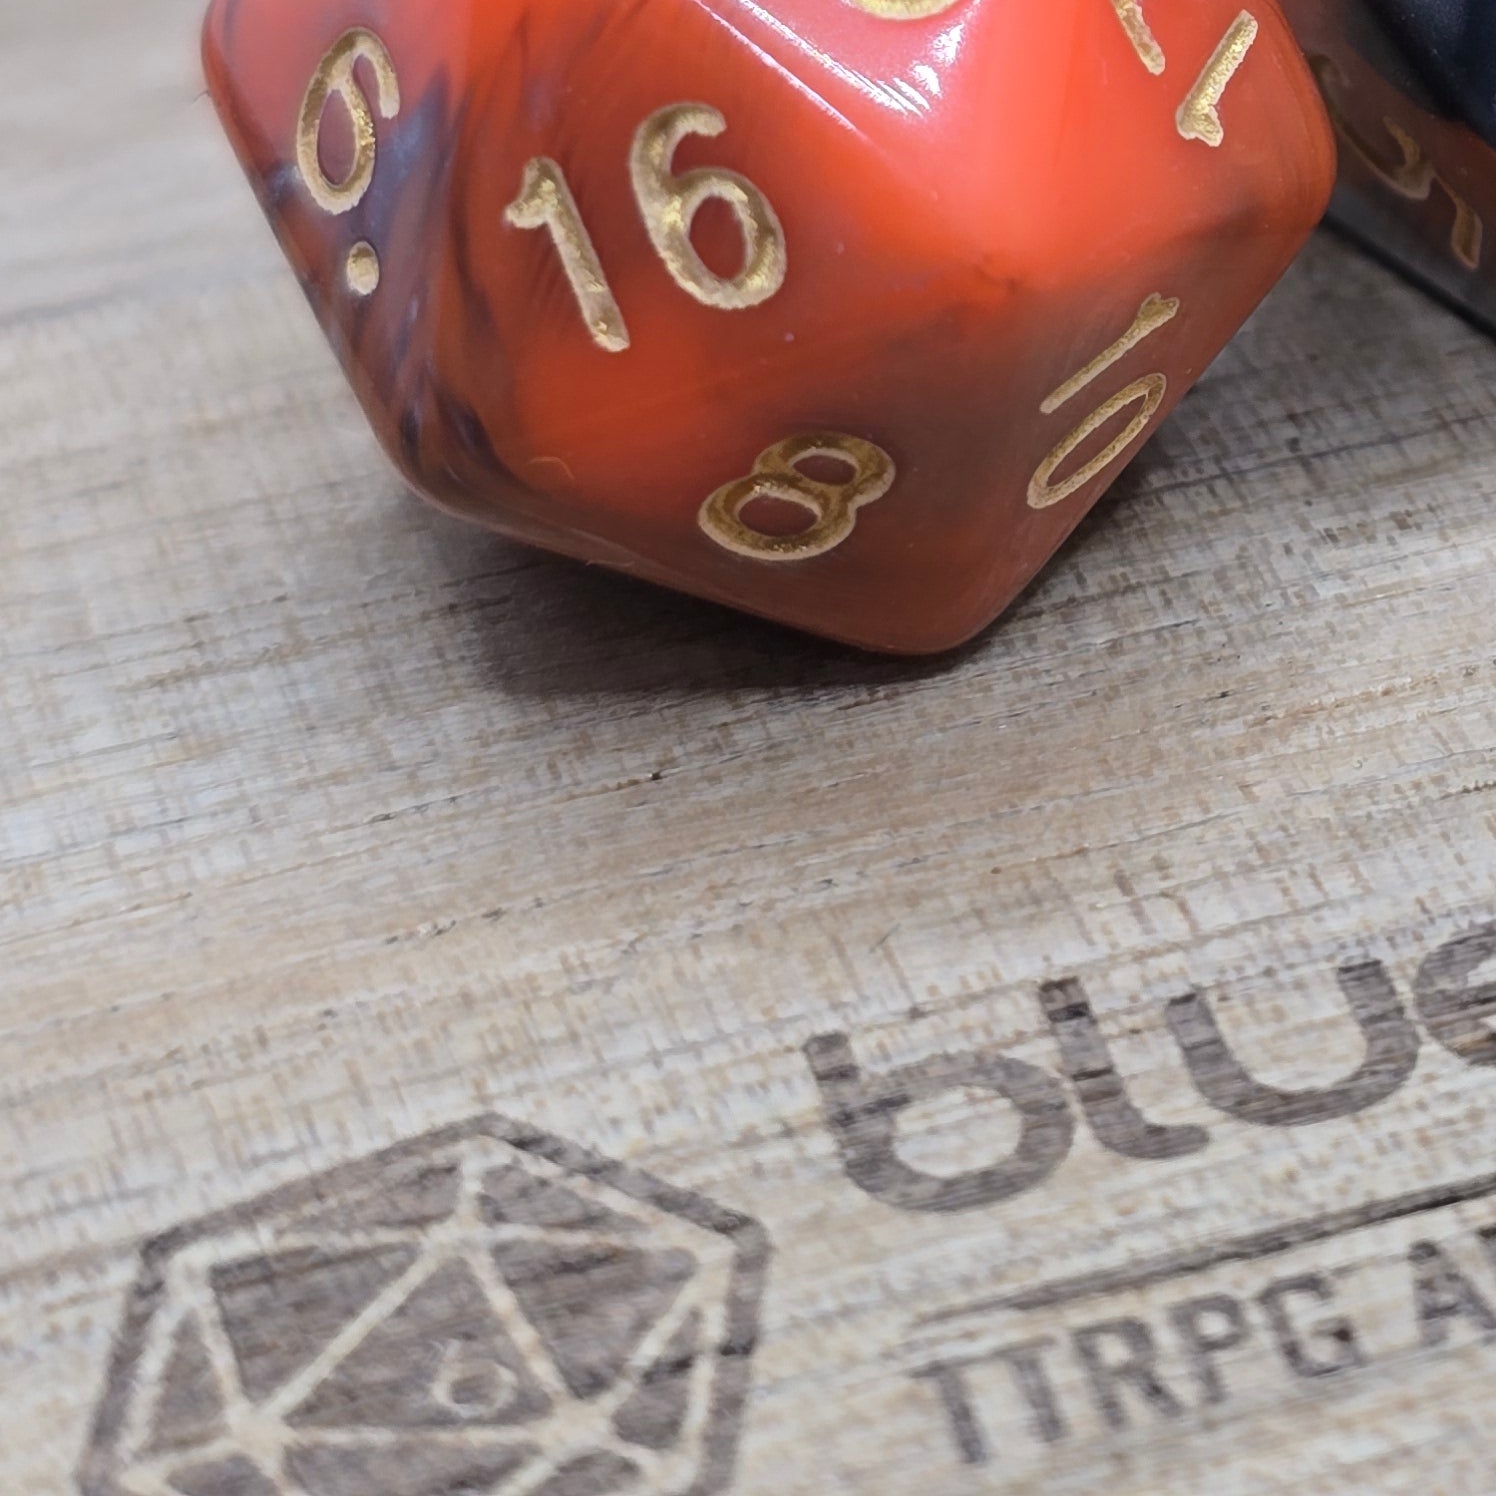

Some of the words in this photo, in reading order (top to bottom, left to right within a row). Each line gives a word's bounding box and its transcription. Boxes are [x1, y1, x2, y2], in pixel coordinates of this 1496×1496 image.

[505, 101, 788, 353] 16
[697, 430, 895, 561] 8
[1027, 292, 1180, 509] 10
[907, 1272, 1367, 1466] TTRPG
